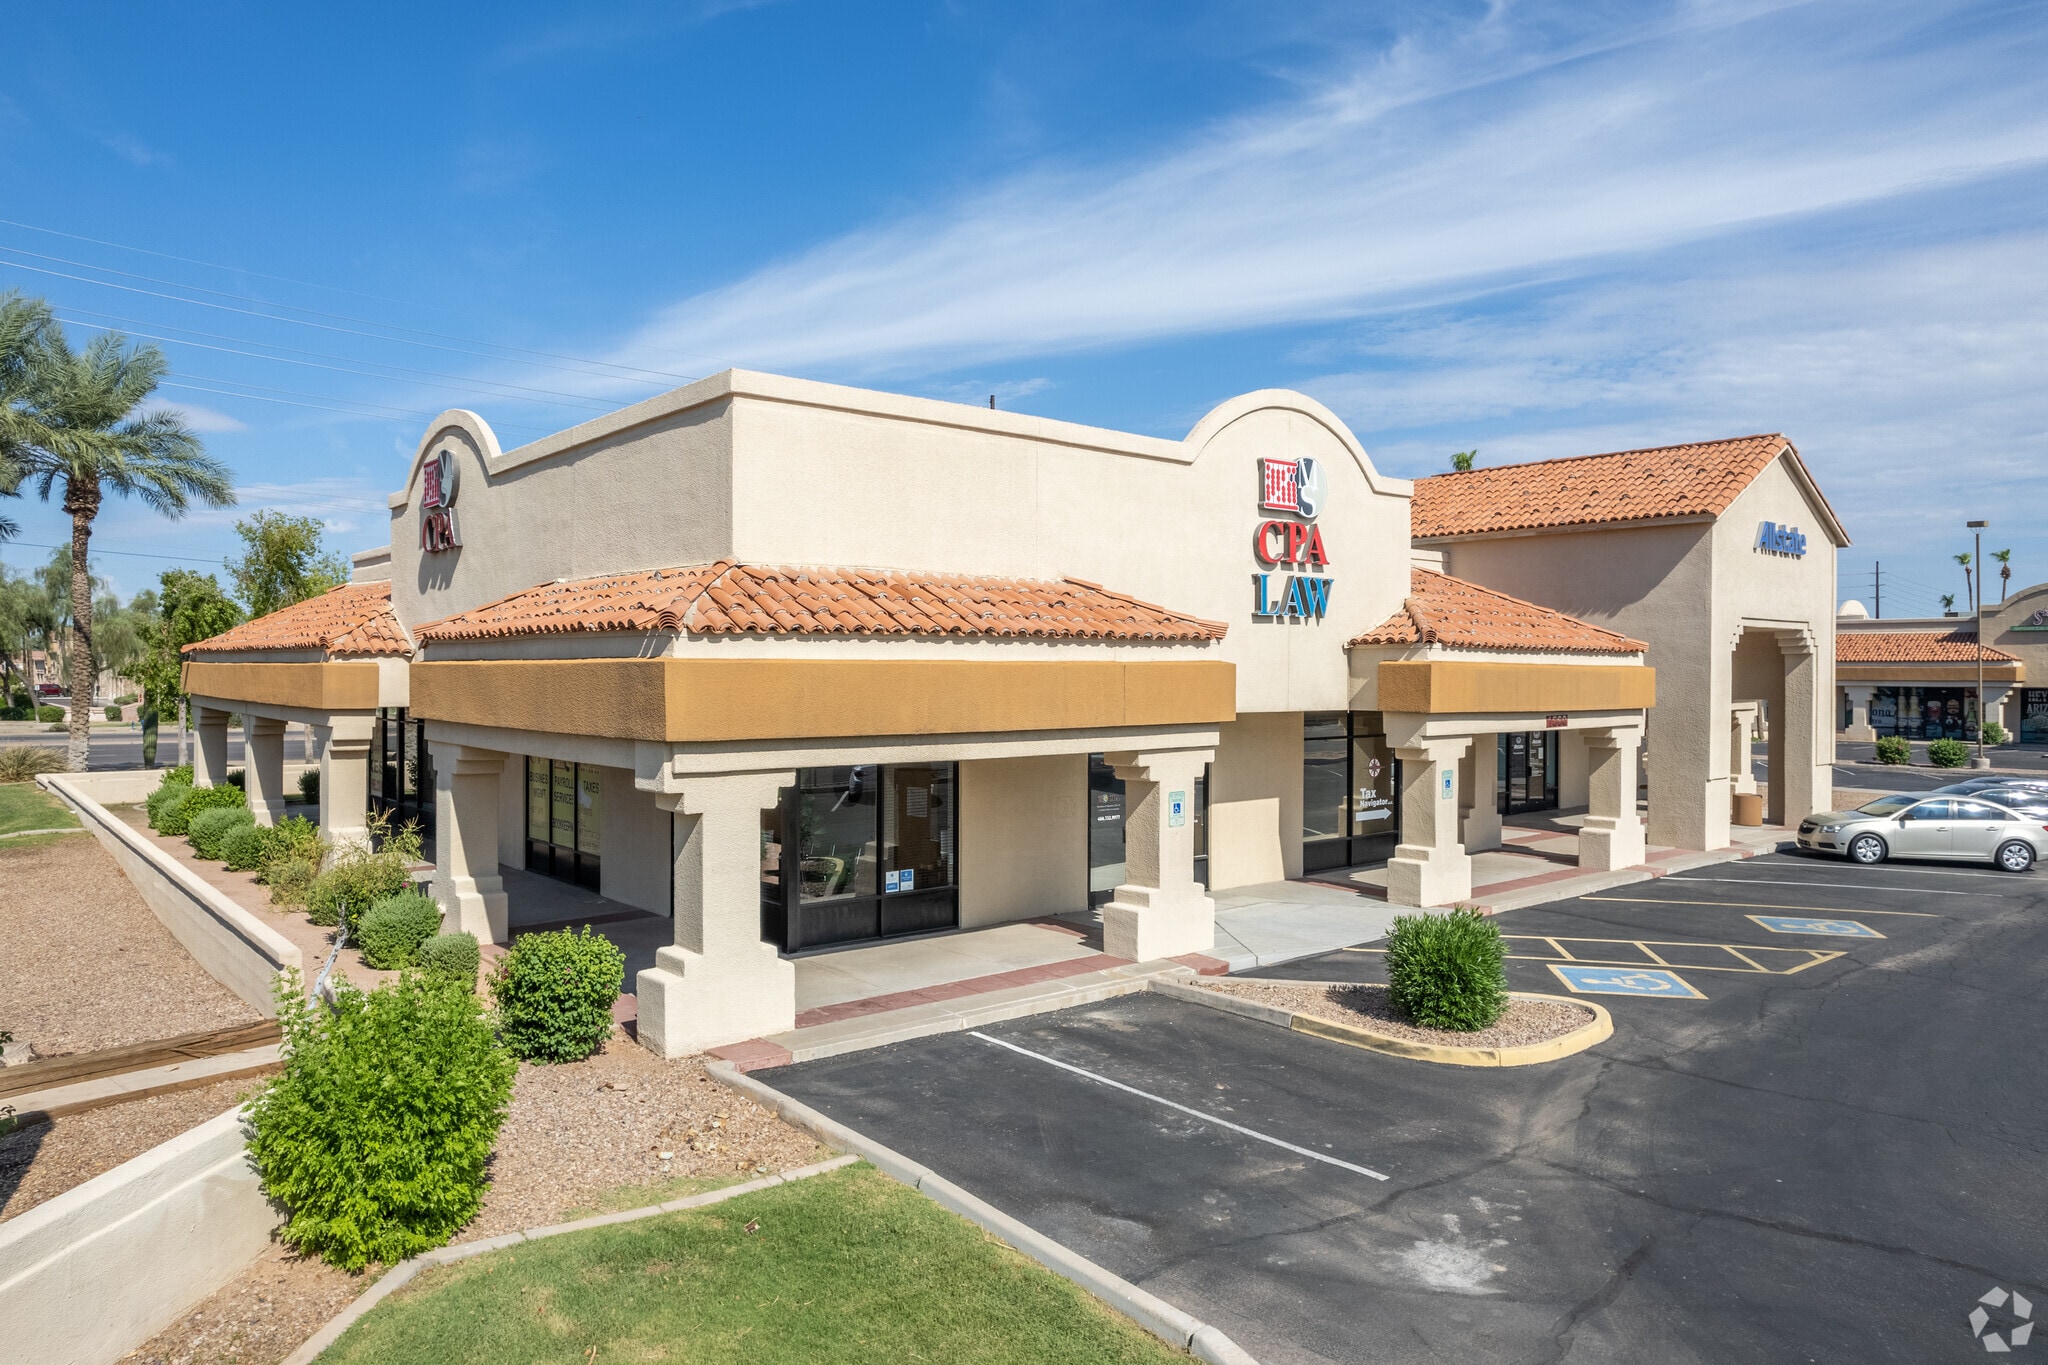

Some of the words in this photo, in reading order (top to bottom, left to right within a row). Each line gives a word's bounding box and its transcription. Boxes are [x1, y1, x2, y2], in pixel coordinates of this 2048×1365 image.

[1257, 520, 1330, 565] CPA
[1758, 520, 1807, 555] Allstate
[1257, 573, 1335, 619] LAW
[583, 780, 600, 794] TAXES
[1360, 787, 1377, 799] Tax
[1360, 798, 1389, 808] Navigator
